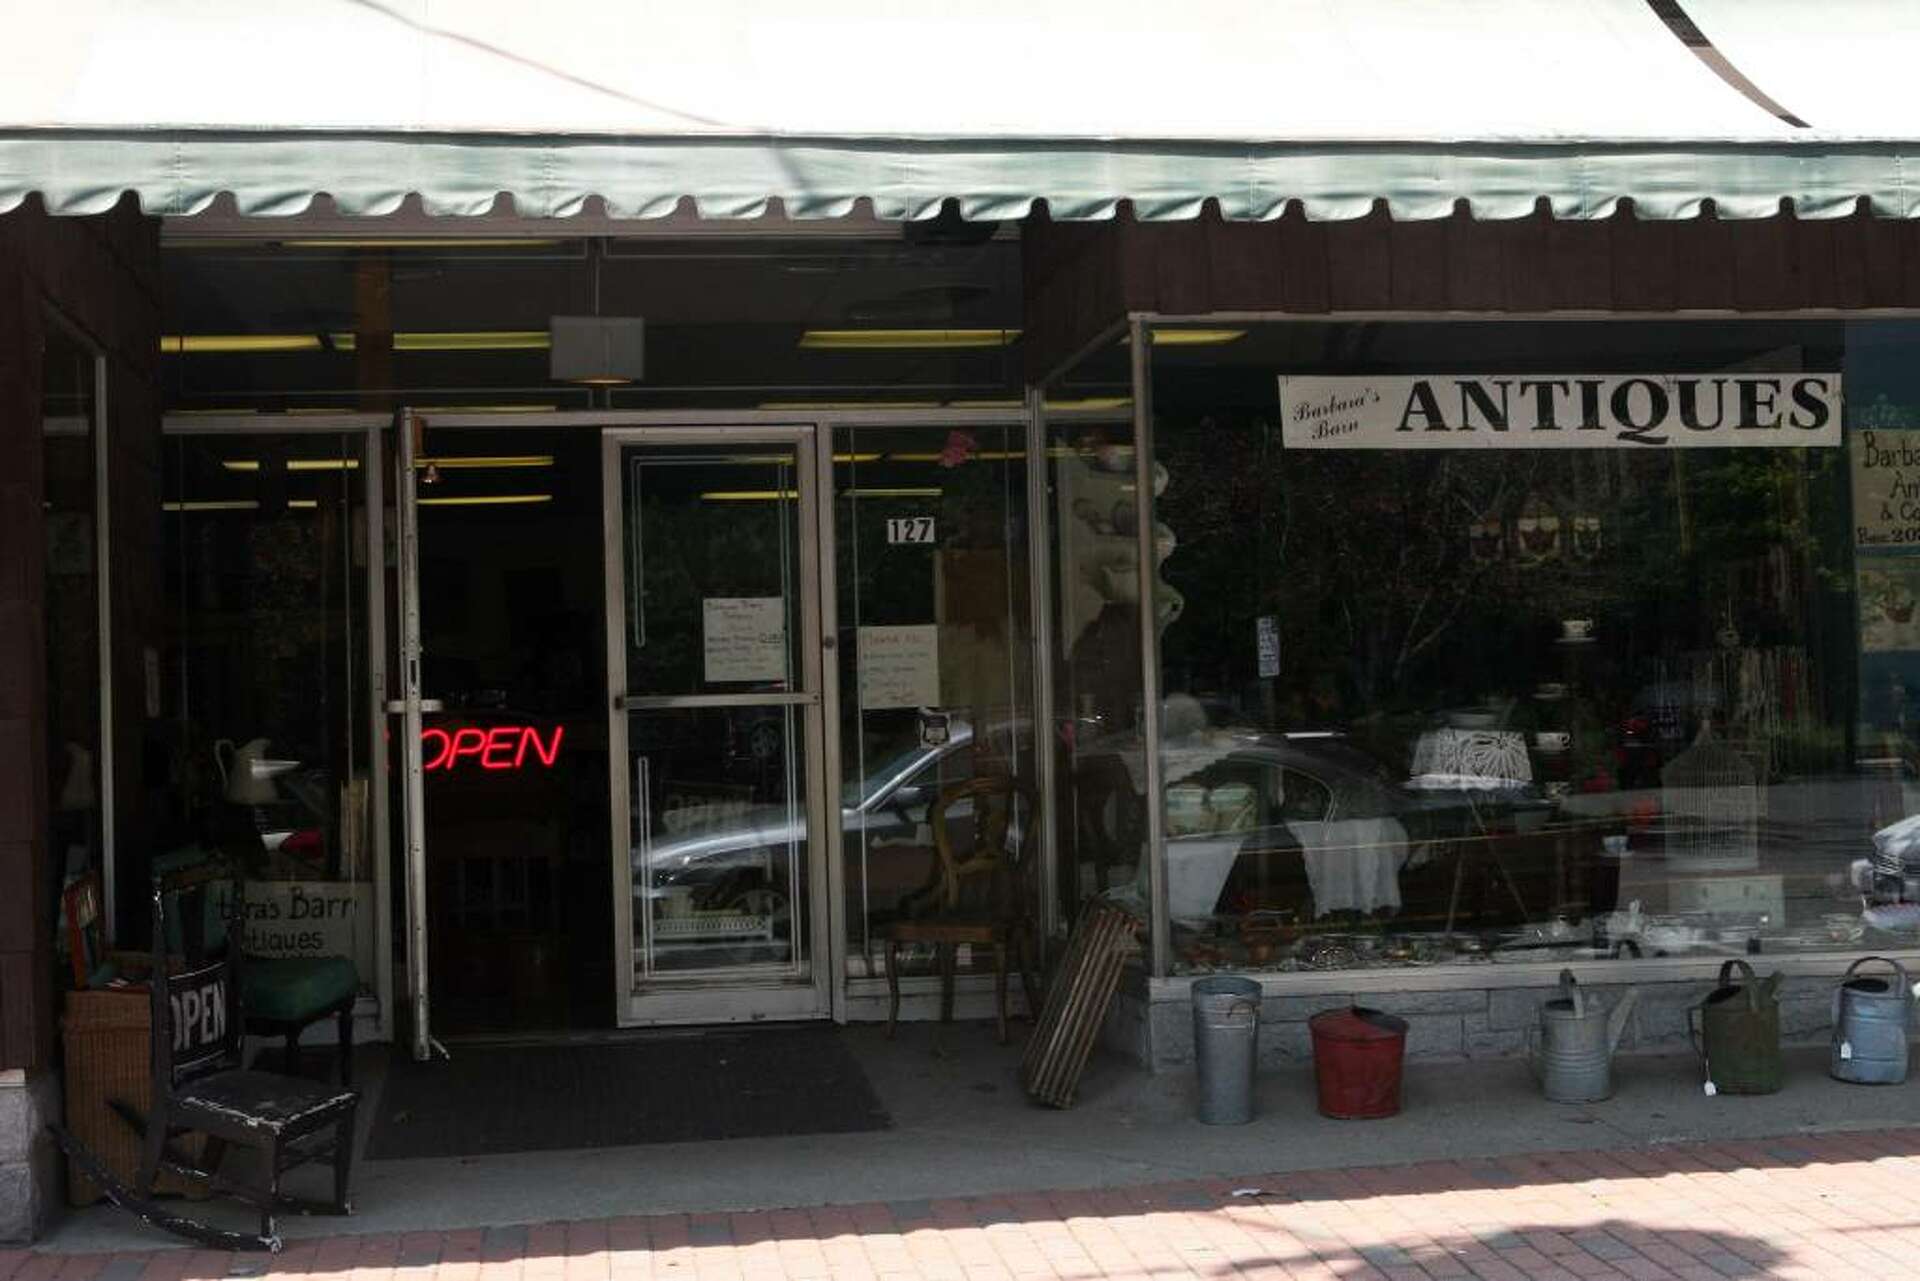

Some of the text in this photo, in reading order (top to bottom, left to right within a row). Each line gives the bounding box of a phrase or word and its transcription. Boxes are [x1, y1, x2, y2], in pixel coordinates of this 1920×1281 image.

[1293, 387, 1380, 420] Barbara's
[1395, 379, 1829, 444] ANTIQUES
[1312, 420, 1359, 440] Barn
[891, 520, 931, 541] 127
